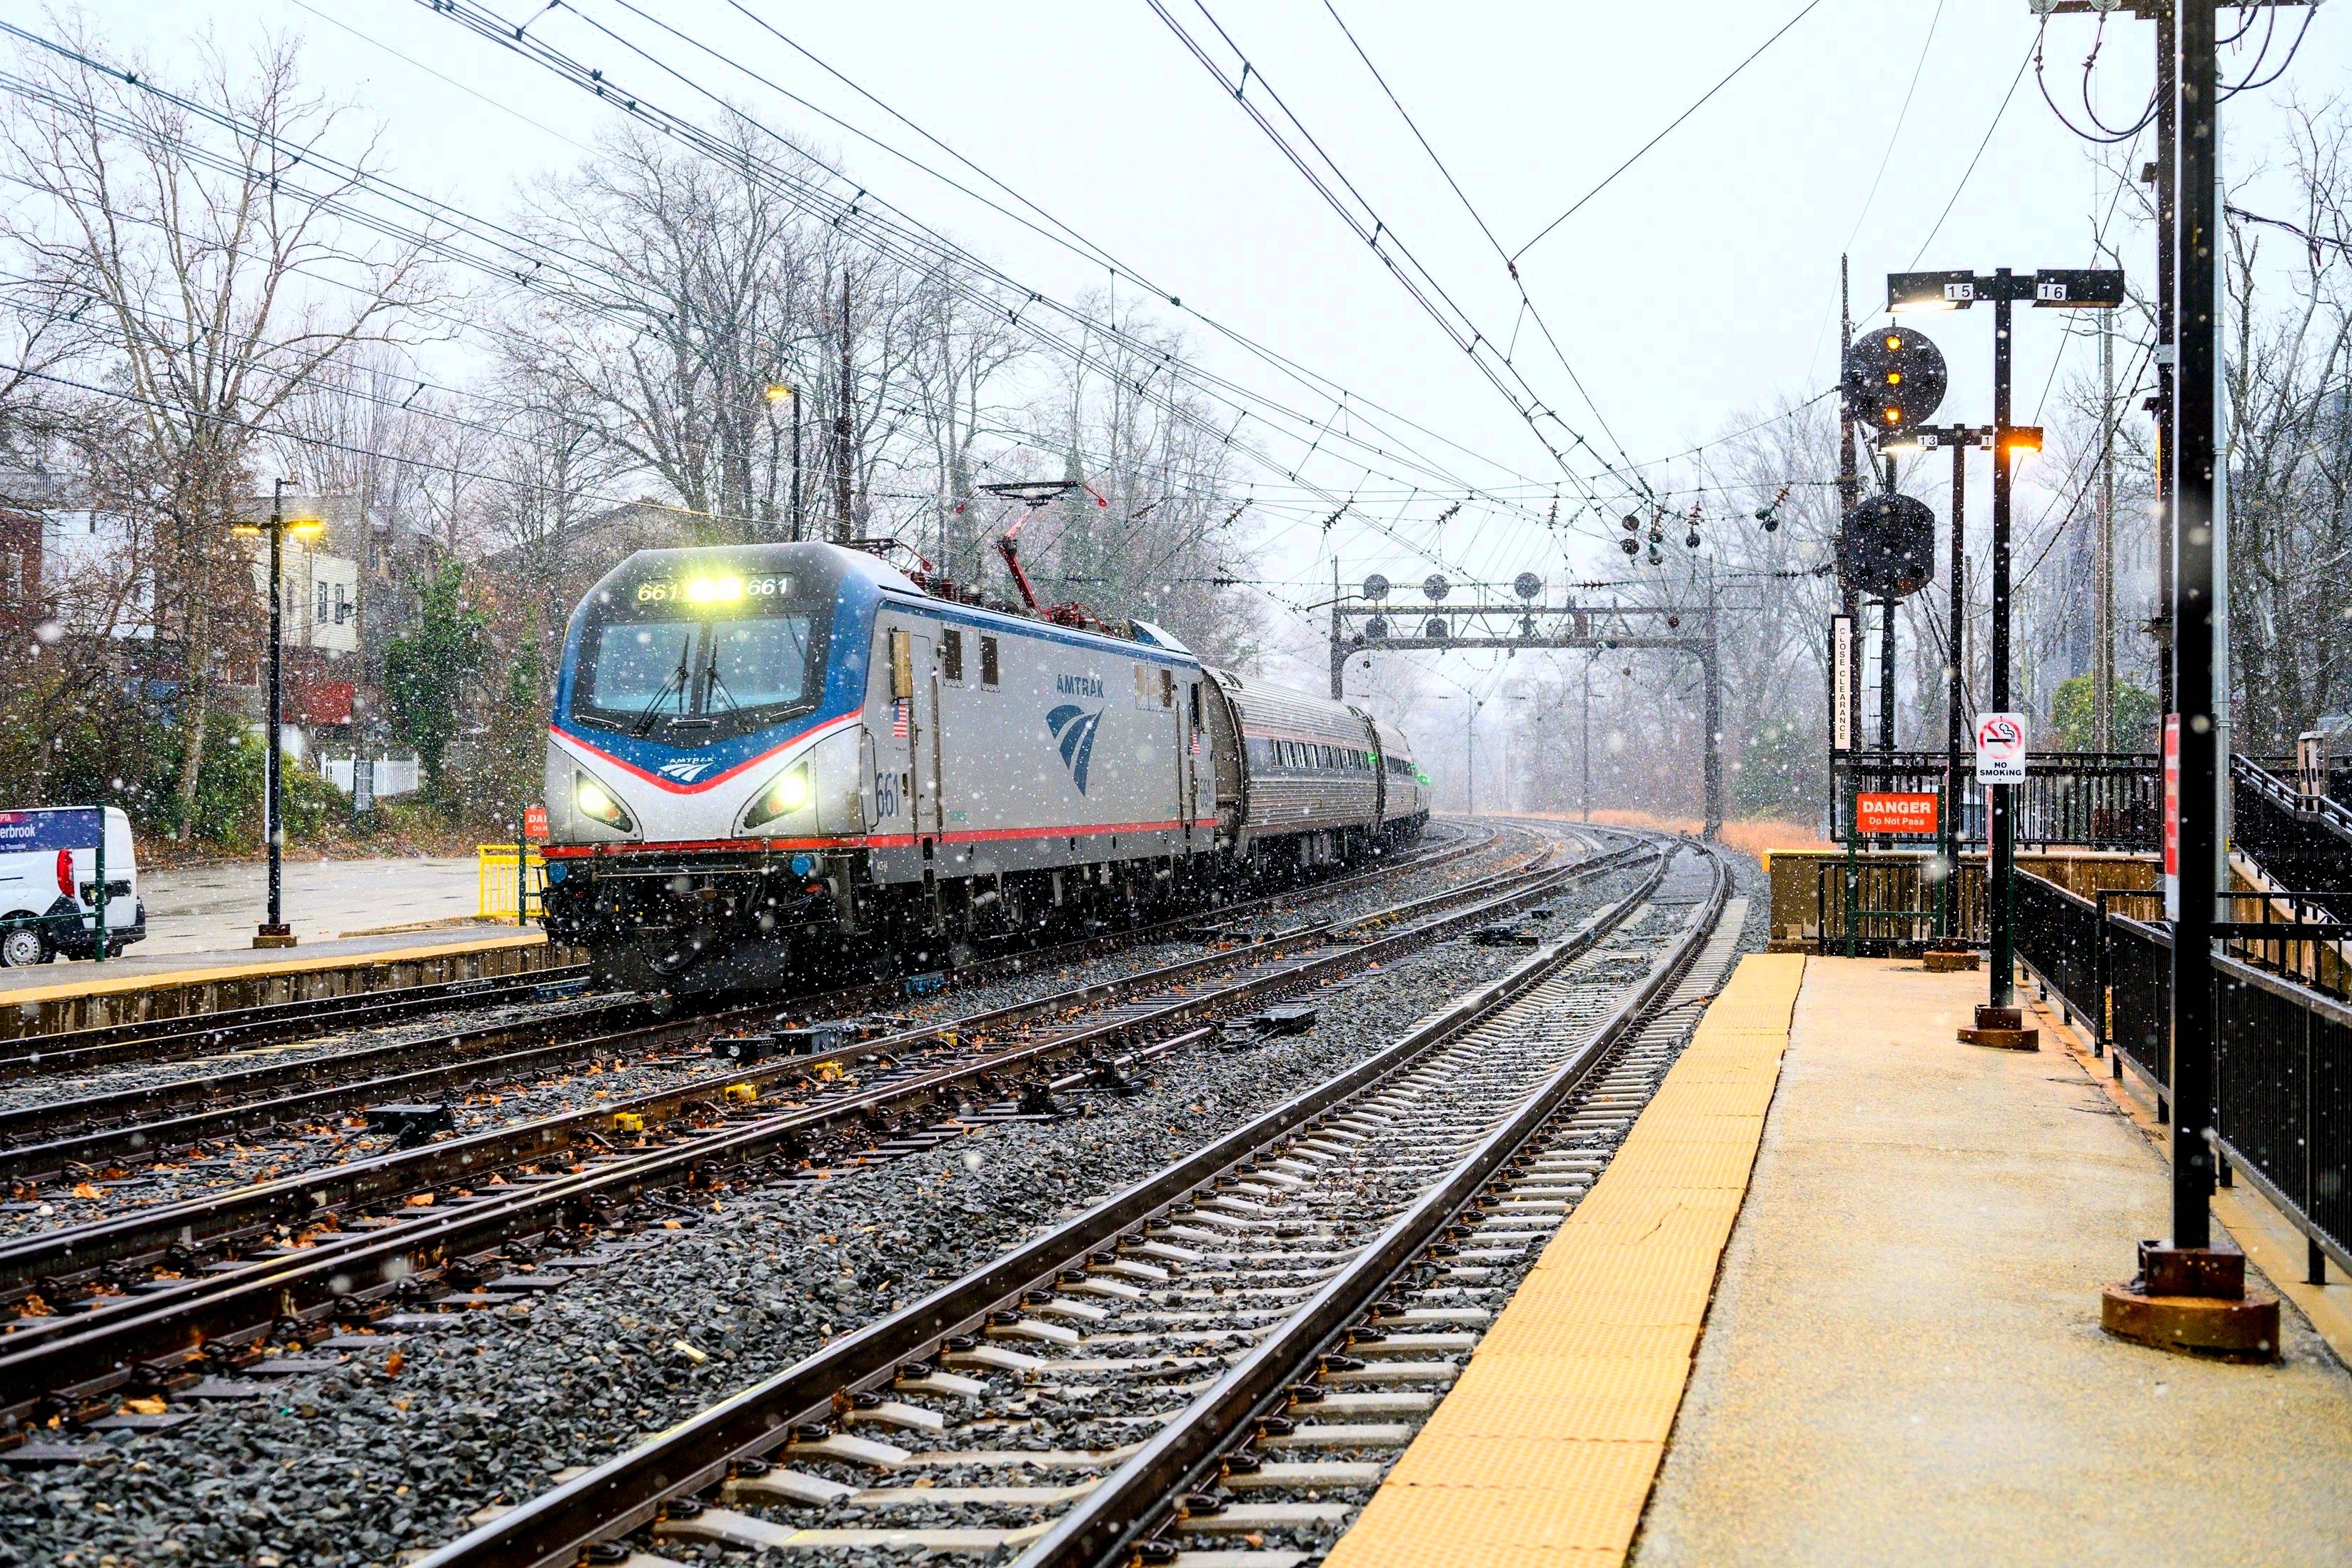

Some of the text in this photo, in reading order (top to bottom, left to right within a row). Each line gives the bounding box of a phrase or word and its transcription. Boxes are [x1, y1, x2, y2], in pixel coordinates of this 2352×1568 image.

[1948, 285, 1971, 298] 15
[2041, 285, 2064, 299] 16
[1920, 436, 1936, 446] 13
[638, 583, 679, 601] 661
[747, 578, 788, 595] 661
[1057, 674, 1104, 698] AMTRAK
[877, 772, 900, 818] 661
[1862, 800, 1931, 814] DANGER
[1869, 816, 1925, 826] Do Not Pass
[0, 823, 36, 838] erbrook
